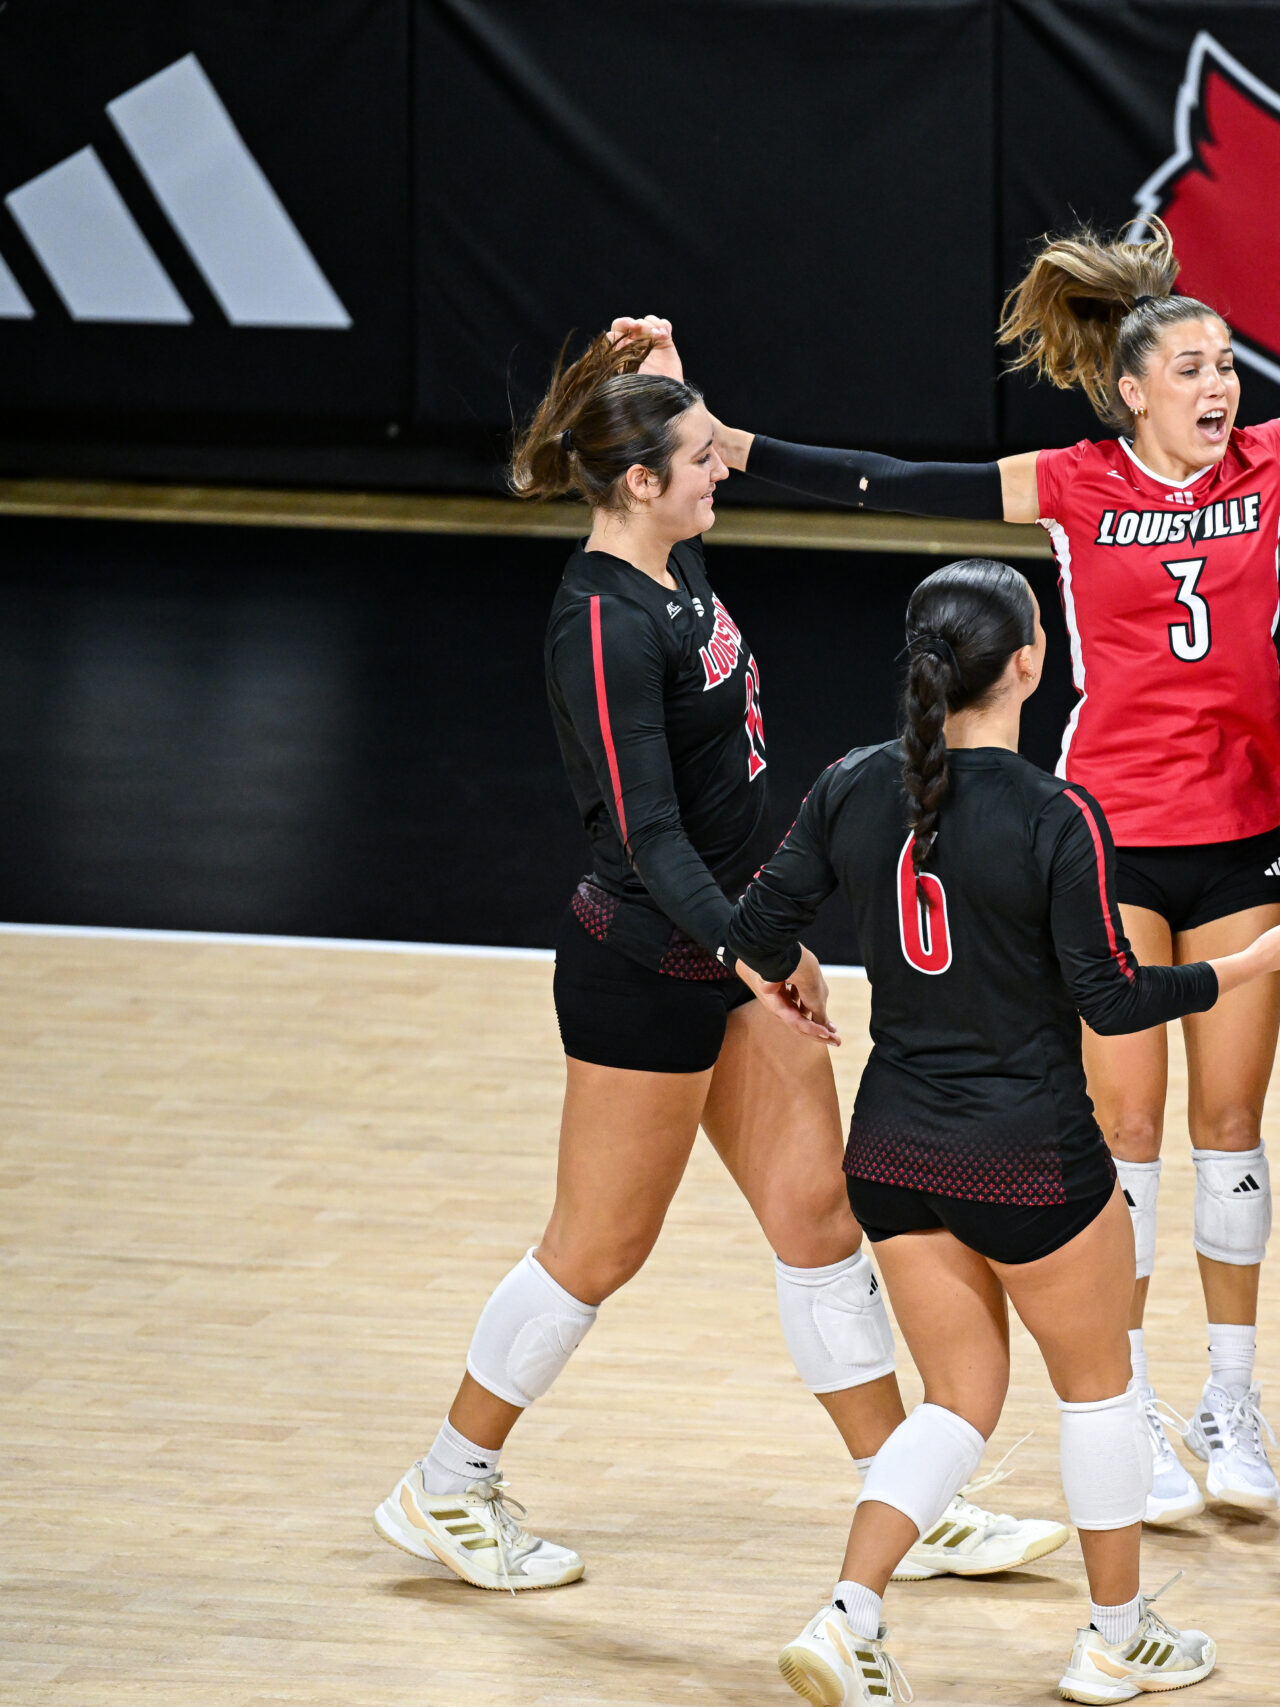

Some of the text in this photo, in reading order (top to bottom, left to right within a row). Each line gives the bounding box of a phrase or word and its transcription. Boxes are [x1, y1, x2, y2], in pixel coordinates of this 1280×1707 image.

[1094, 492, 1261, 549] LOUISVILLE
[1160, 556, 1212, 663] 3
[896, 829, 953, 976] 6
